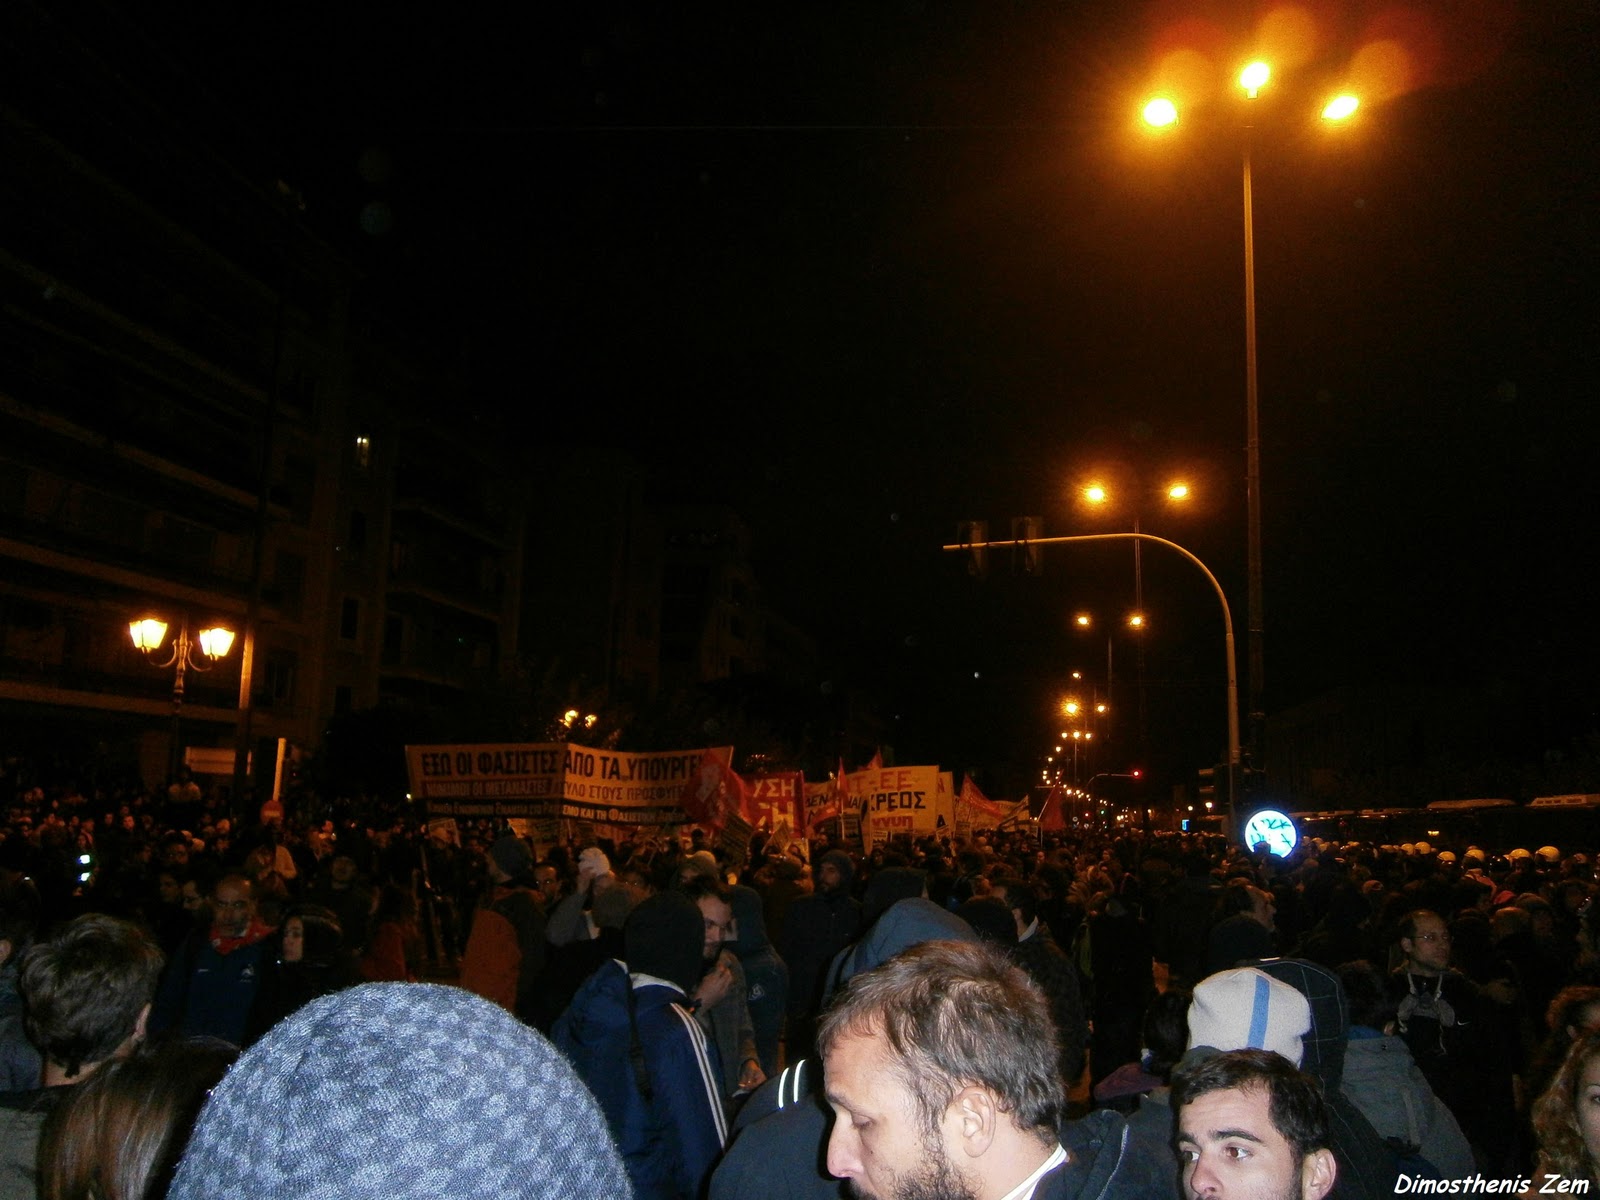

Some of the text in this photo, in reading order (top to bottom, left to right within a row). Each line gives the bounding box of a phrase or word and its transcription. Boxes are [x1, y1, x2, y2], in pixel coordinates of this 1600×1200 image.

[421, 752, 451, 775] ΕΞΩ
[456, 752, 472, 775] ΟΙ
[477, 750, 557, 775] ΦΑΣΙΣΤΕΣ
[563, 749, 594, 777] ΑΠΟ
[600, 756, 620, 780] ΤΑ
[588, 785, 623, 801] ΣΤΟΥΣ
[580, 807, 595, 819] ΚΑΙ
[596, 809, 607, 821] ΤΗ
